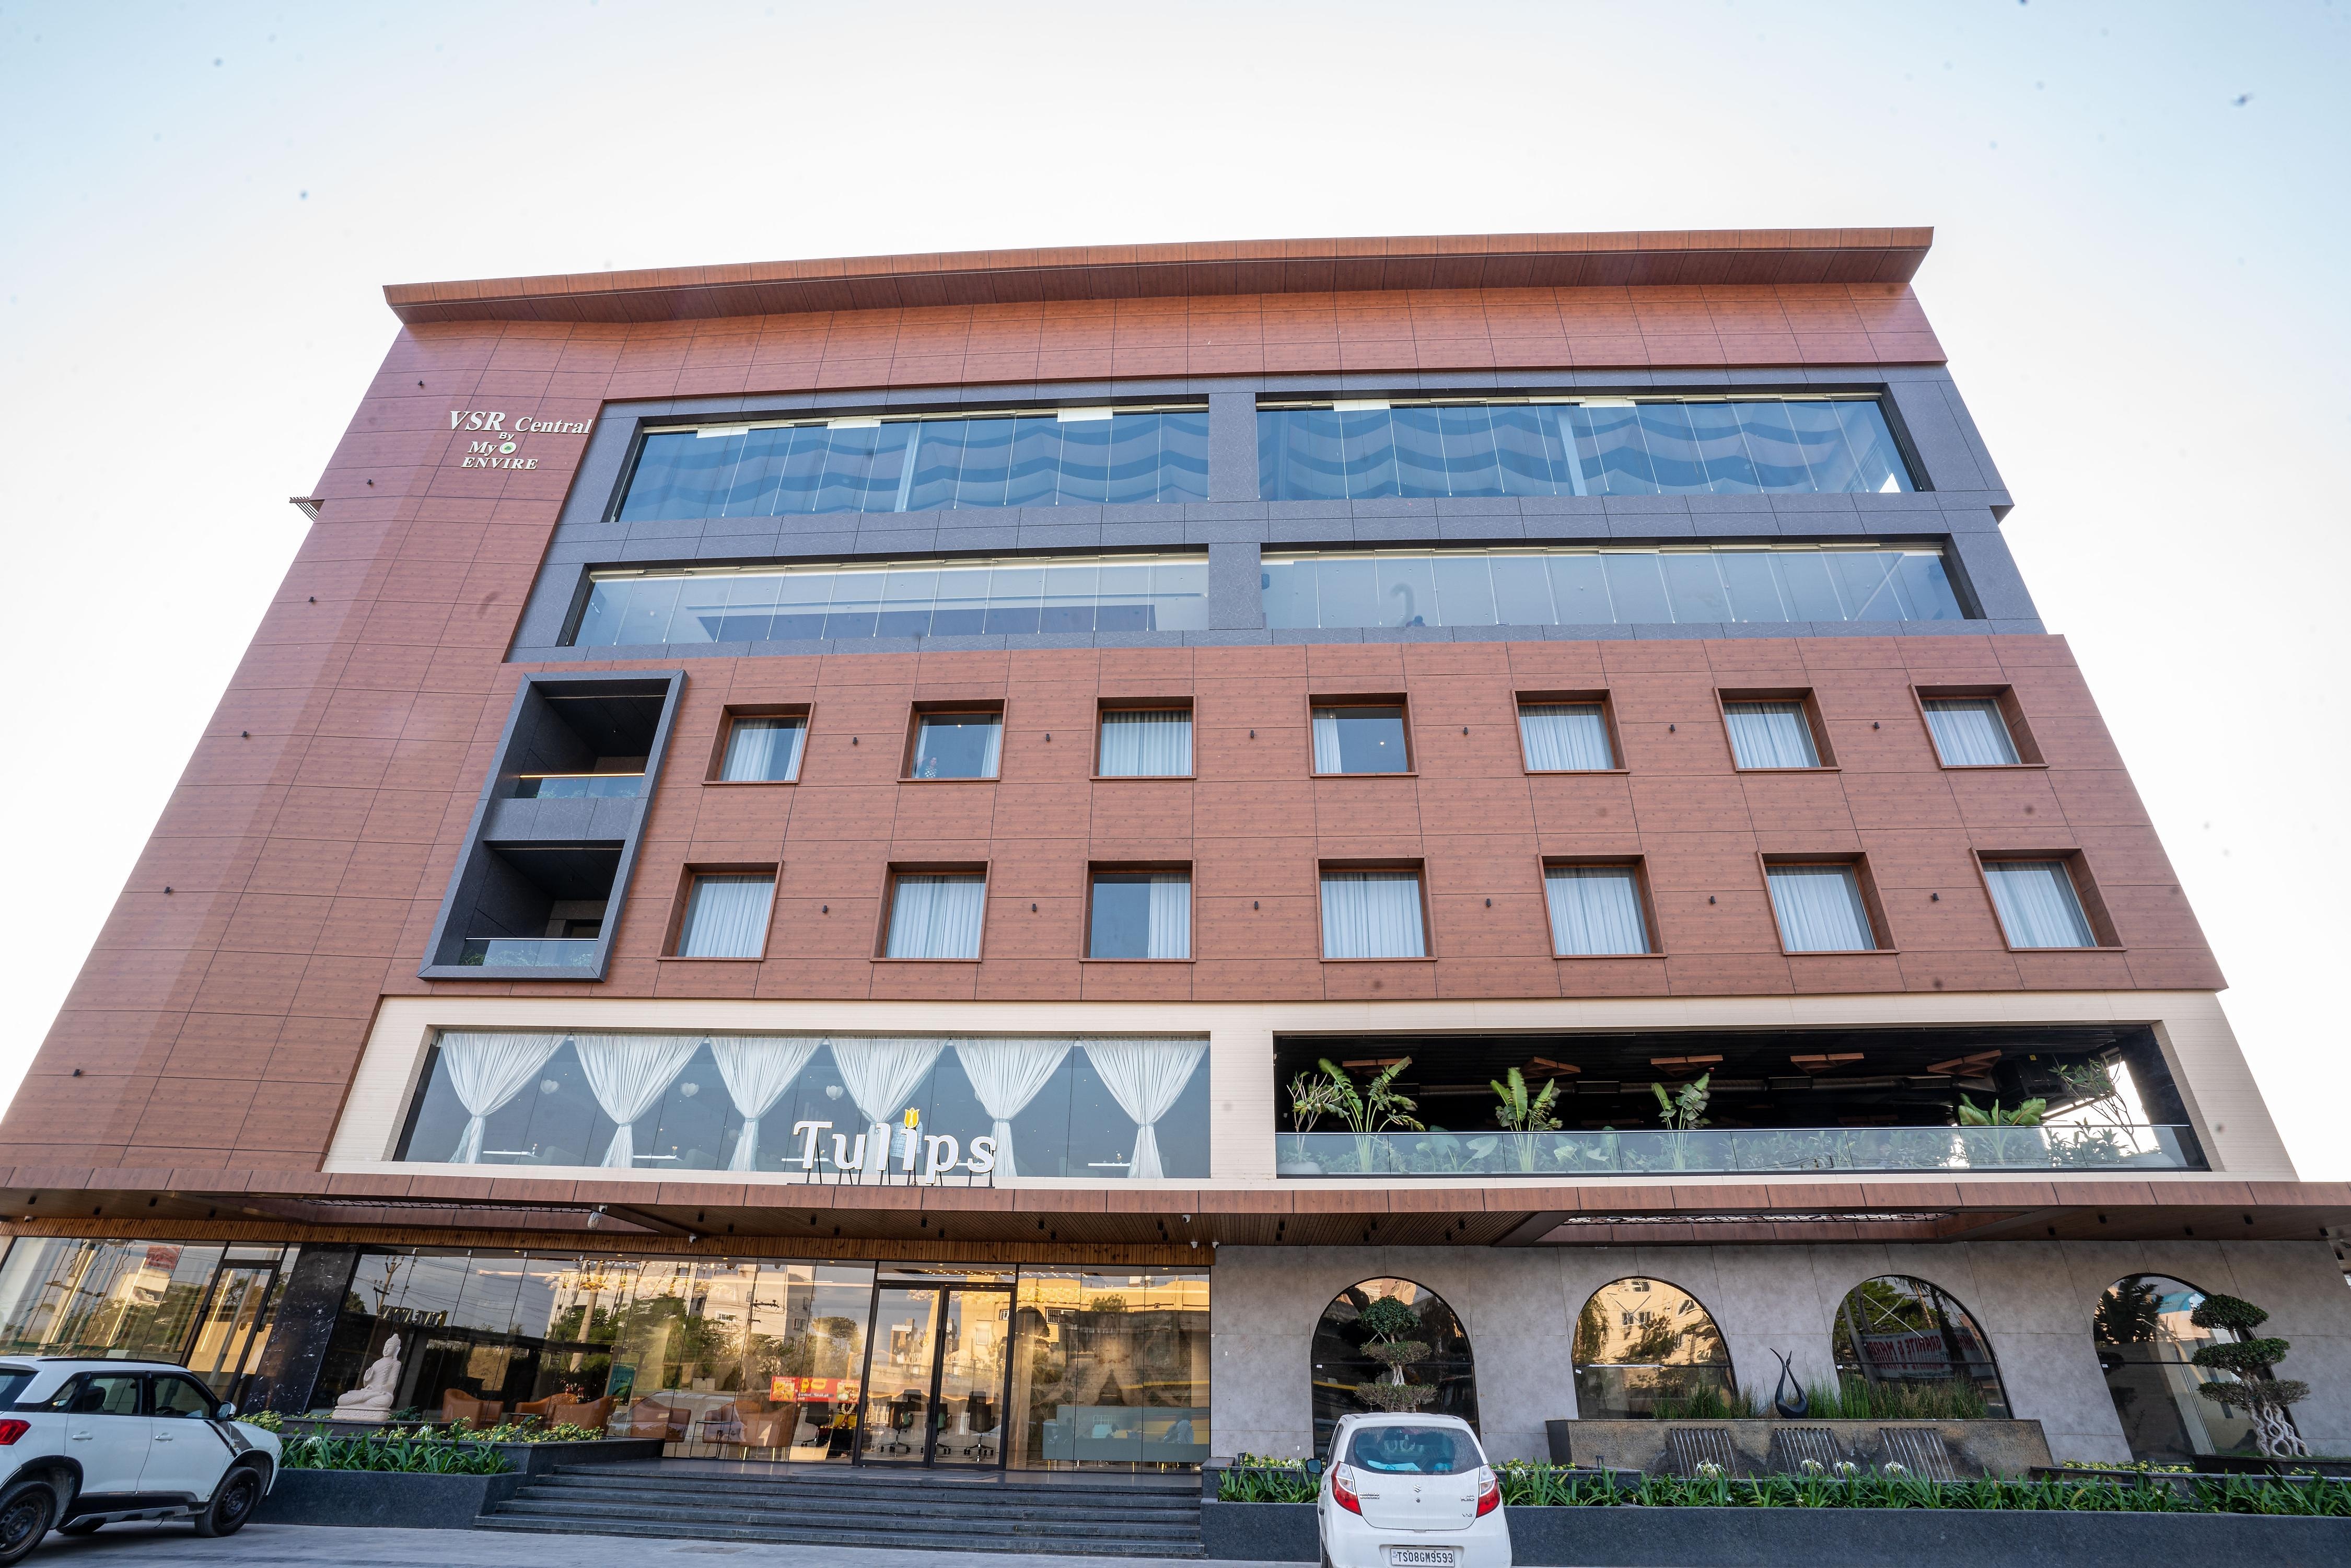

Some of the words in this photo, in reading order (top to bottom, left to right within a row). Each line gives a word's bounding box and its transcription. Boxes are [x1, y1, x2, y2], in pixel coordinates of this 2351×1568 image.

[450, 411, 506, 432] VSR
[515, 416, 593, 434] Central
[498, 432, 515, 441] By
[467, 441, 497, 456] My
[461, 457, 539, 469] ENVIRE
[793, 1107, 997, 1184] Tulips
[1397, 1551, 1453, 1563] TS08GM9593
